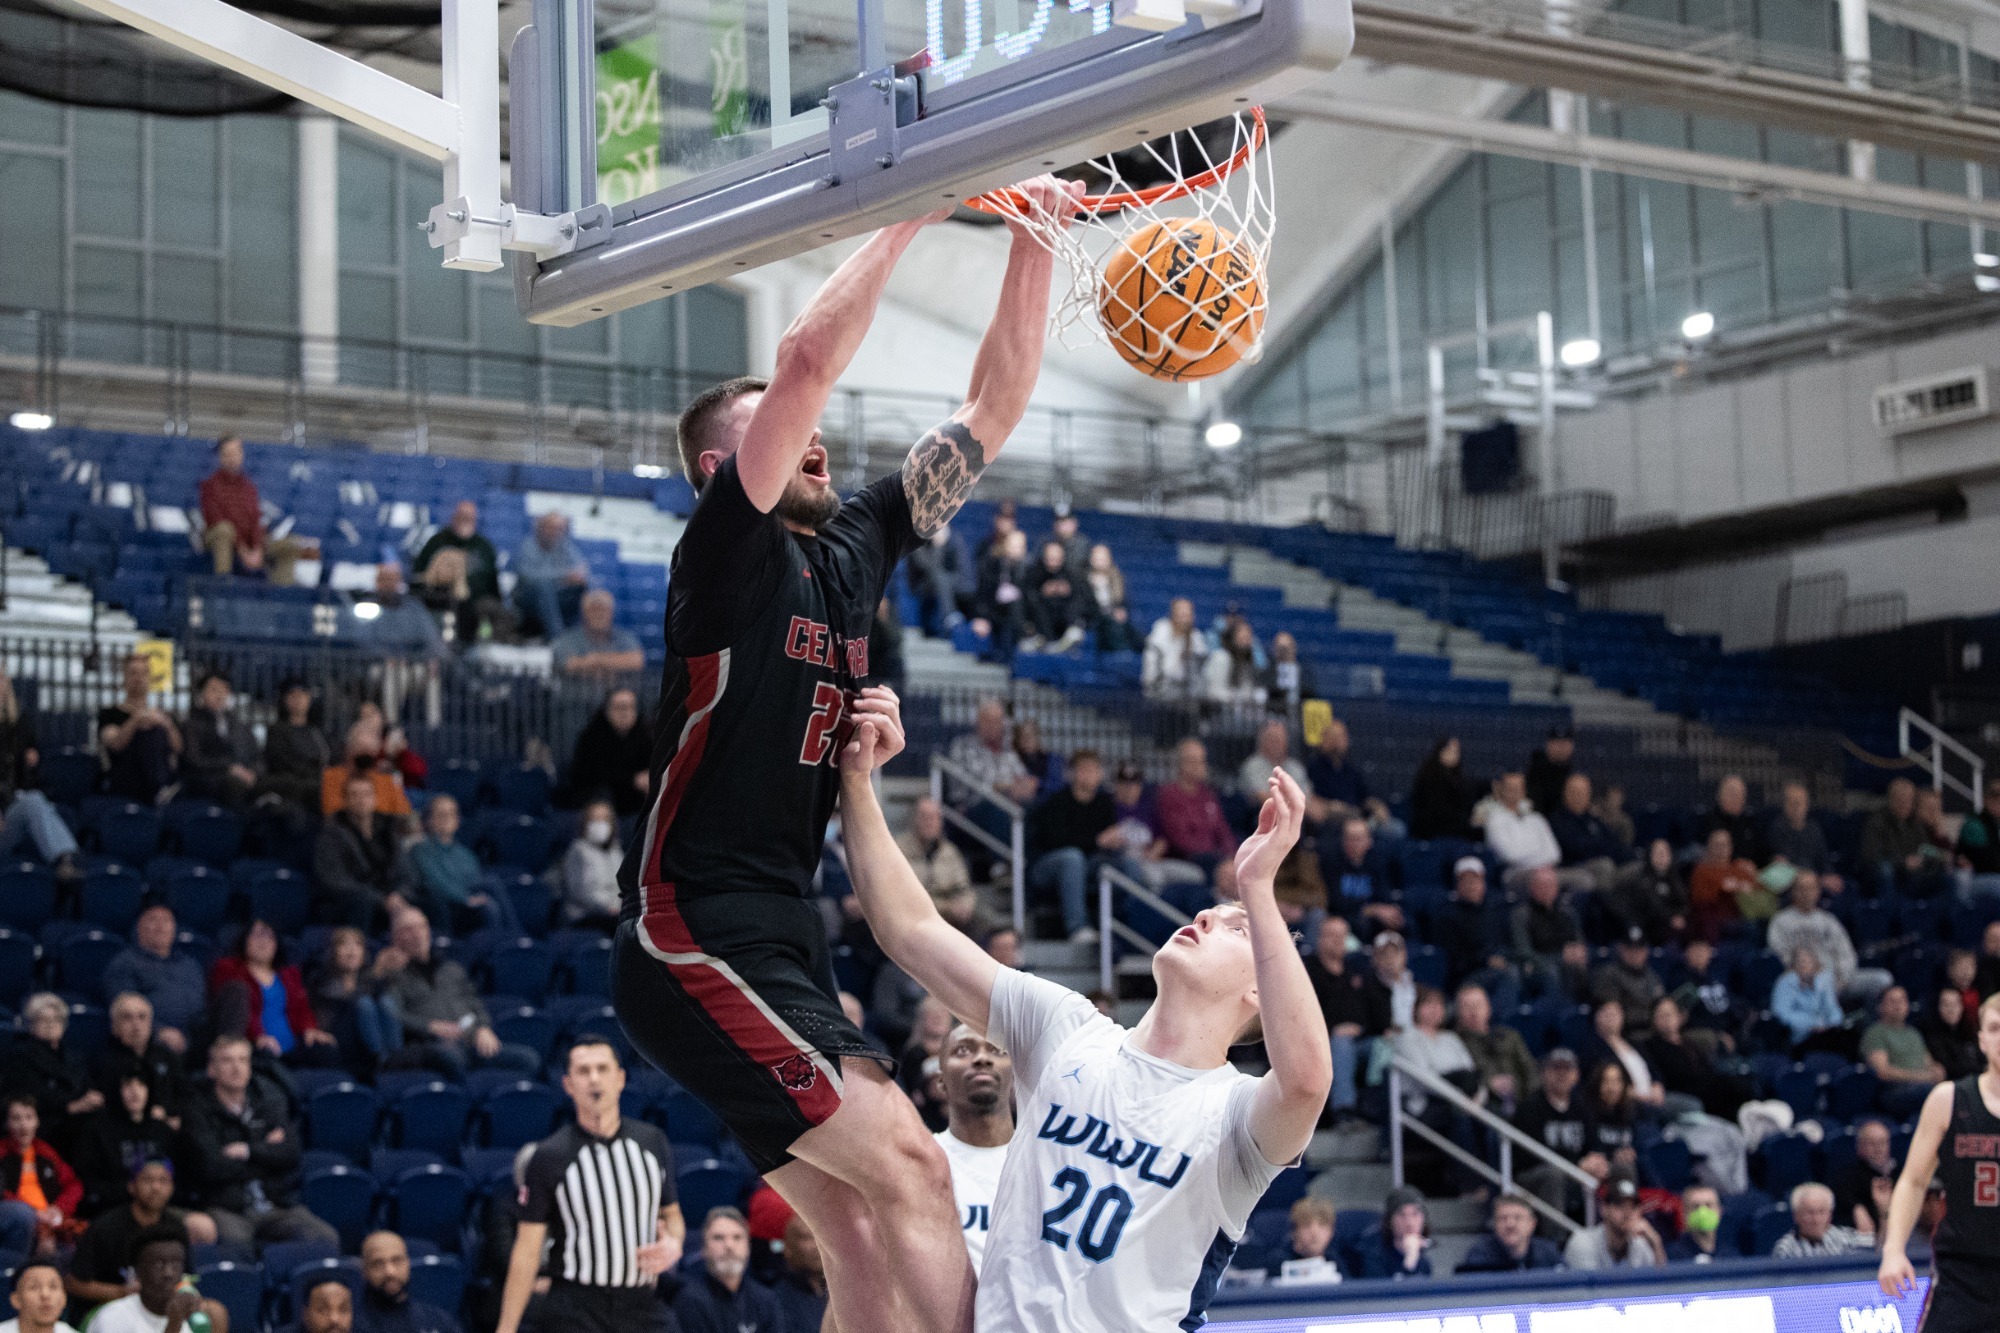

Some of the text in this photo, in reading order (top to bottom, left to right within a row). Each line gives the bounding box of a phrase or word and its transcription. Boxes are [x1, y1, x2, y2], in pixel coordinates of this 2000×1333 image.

[1162, 229, 1202, 302] NCAA
[1037, 1102, 1192, 1190] WWU
[1041, 1164, 1135, 1264] 20
